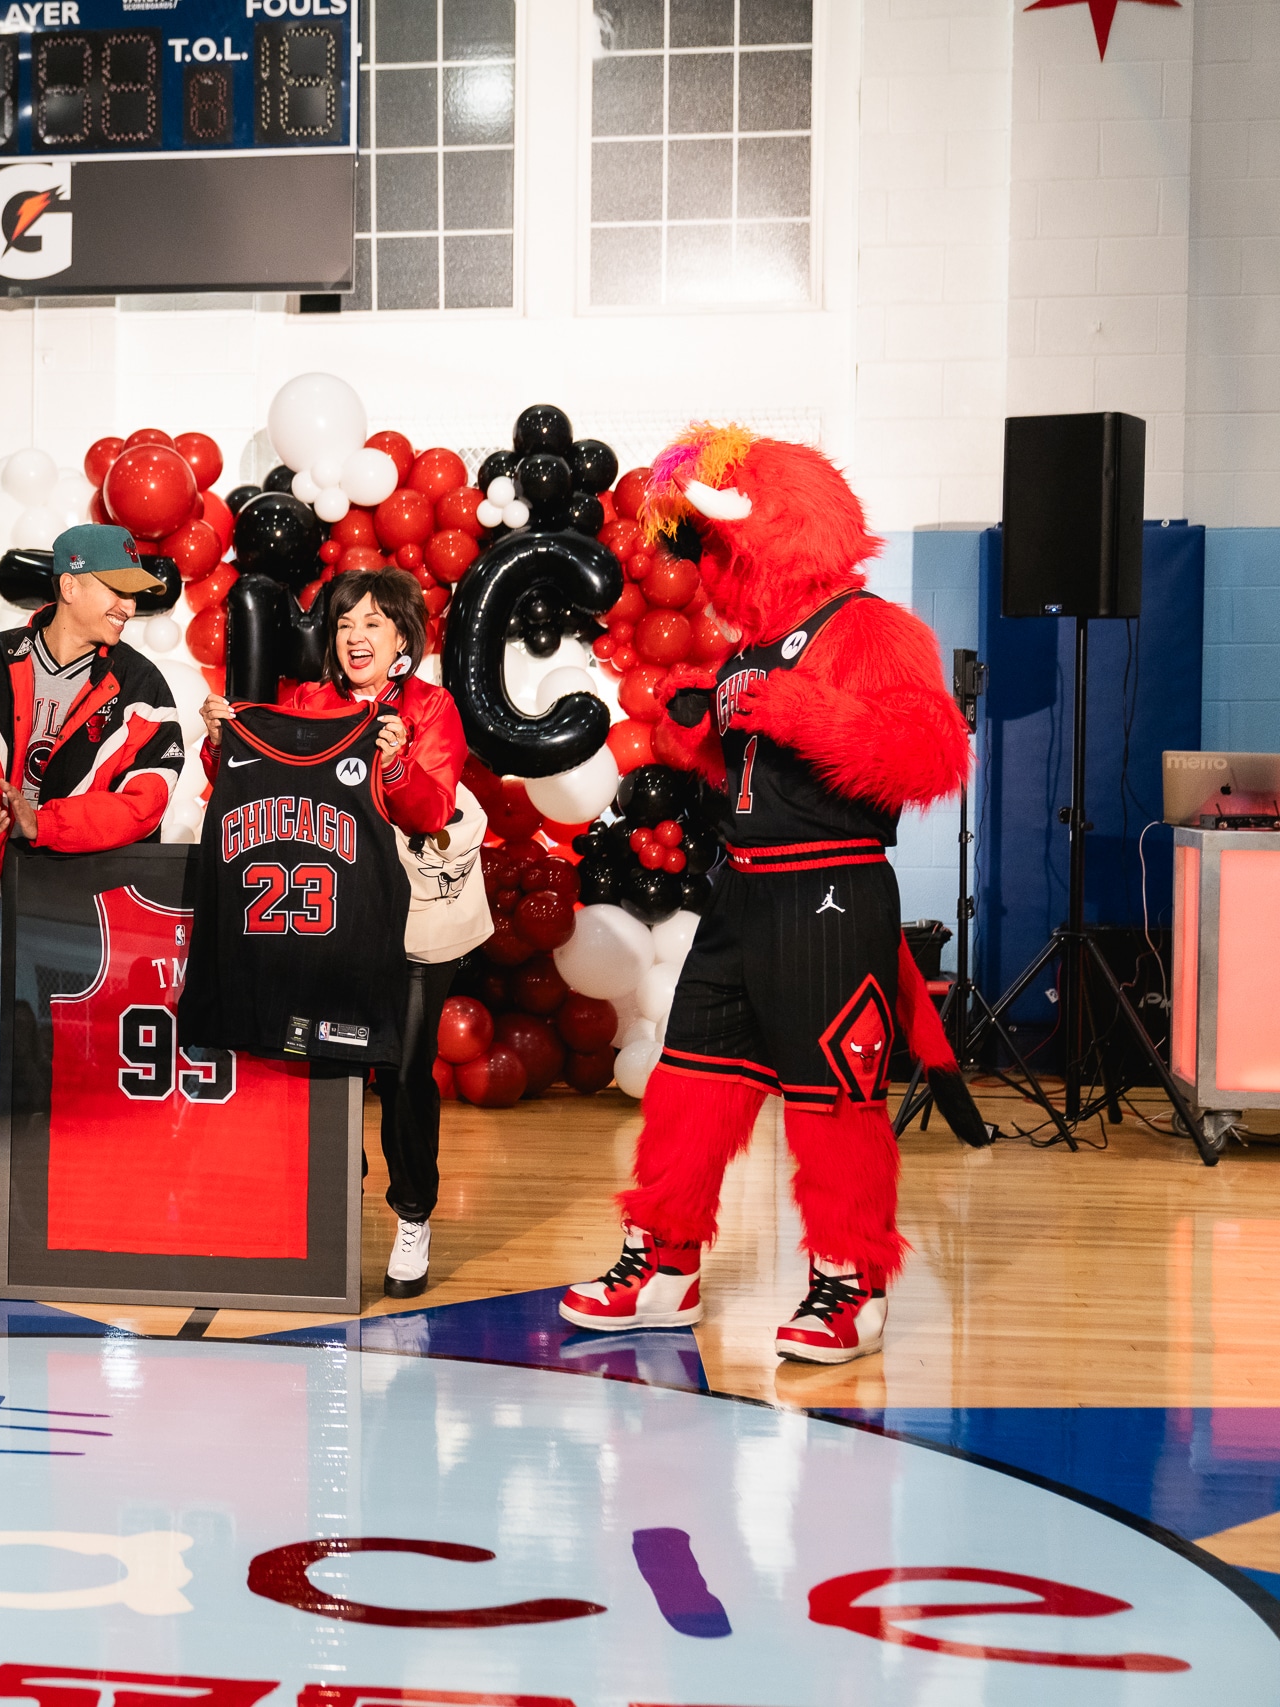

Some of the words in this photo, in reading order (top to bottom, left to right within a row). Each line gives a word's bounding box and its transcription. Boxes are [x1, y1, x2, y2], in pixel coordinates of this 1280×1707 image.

[246, 0, 348, 18] FOULS
[168, 37, 249, 63] T.O.L.
[735, 735, 758, 814] 1
[221, 795, 357, 865] CHICAGO
[242, 862, 338, 936] 23
